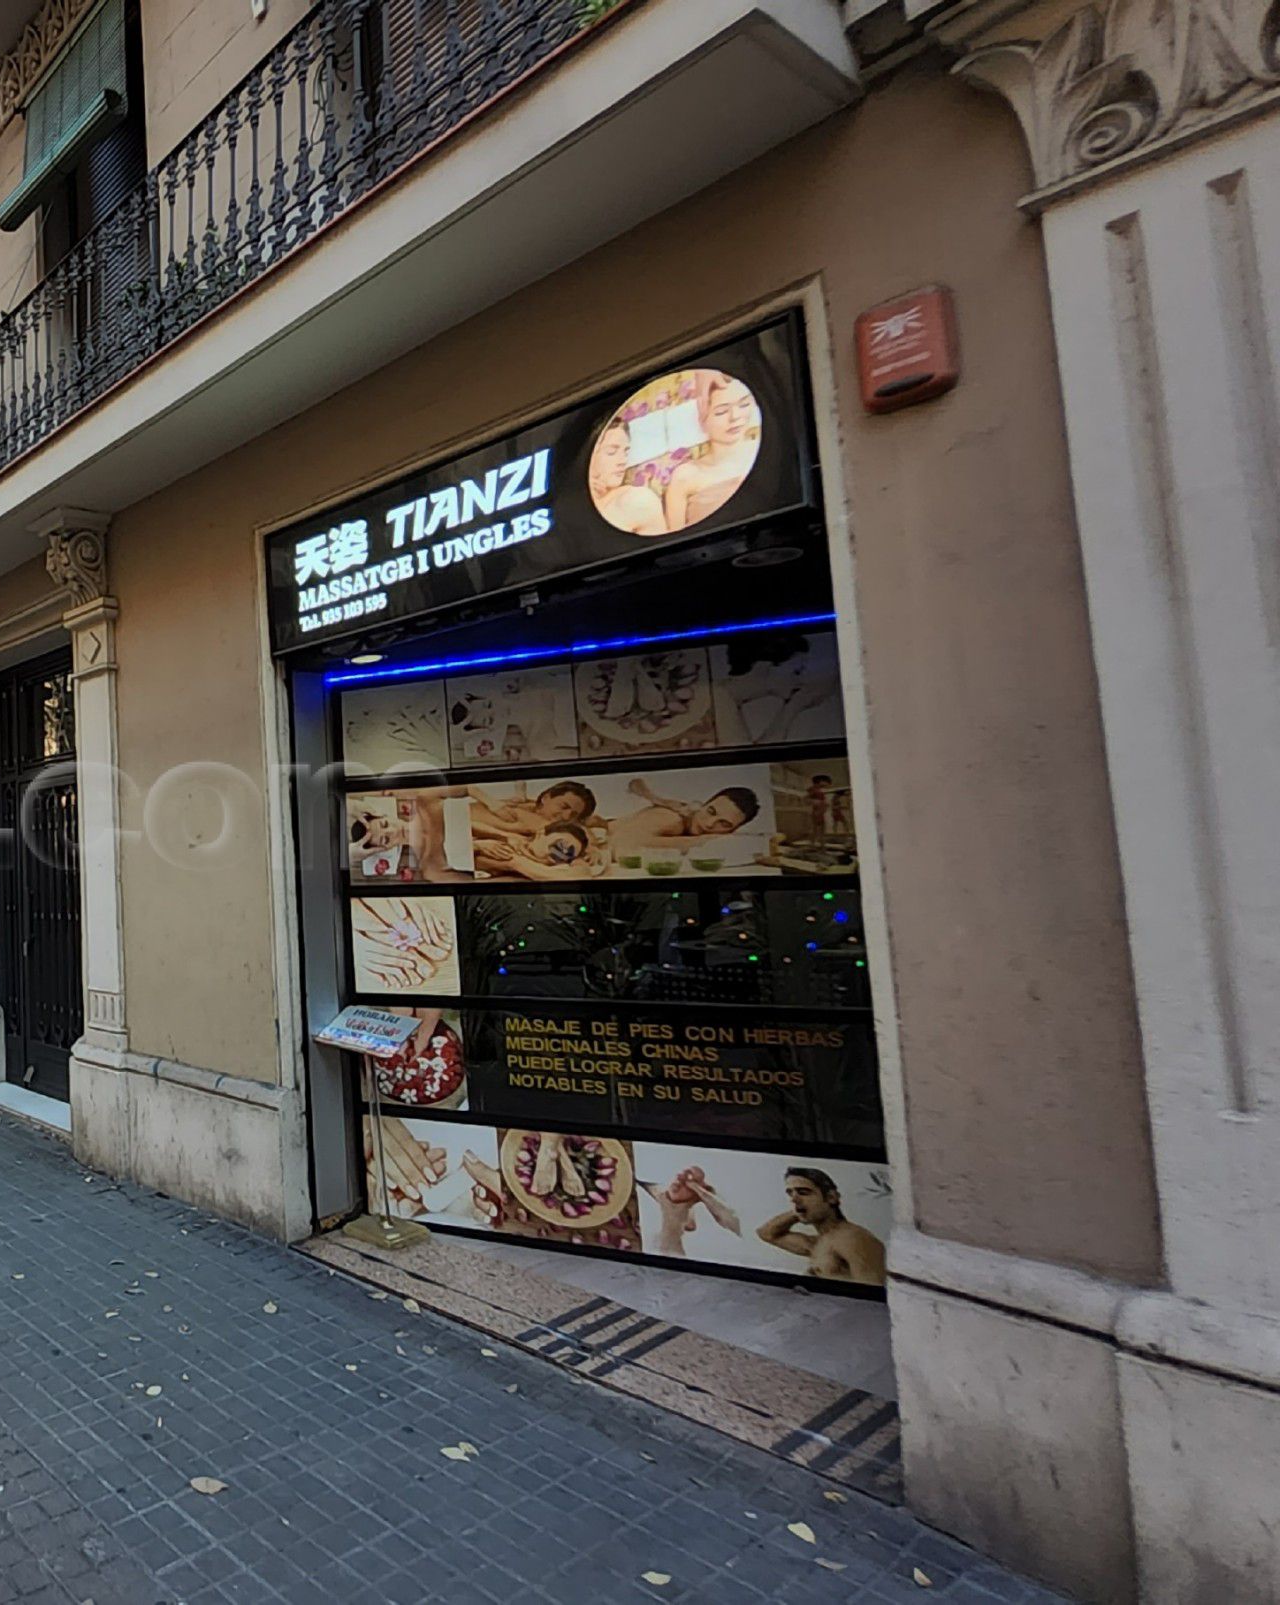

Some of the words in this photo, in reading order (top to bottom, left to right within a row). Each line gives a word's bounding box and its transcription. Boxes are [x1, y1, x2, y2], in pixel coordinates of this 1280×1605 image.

[386, 448, 551, 548] TIANZI
[294, 519, 369, 586] 天姿
[298, 553, 414, 612] MASSATGE
[418, 550, 430, 574] I
[432, 508, 552, 567] UNGLES
[505, 1017, 581, 1035] MASAJE
[591, 1021, 619, 1036] DE
[629, 1023, 673, 1039] PIES
[685, 1026, 734, 1043] CON
[744, 1028, 844, 1047] HIERBAS
[505, 1036, 631, 1057] MEDICINALES
[641, 1043, 719, 1061] CHINAS
[507, 1054, 567, 1071] PUEDE
[570, 1059, 653, 1078] LOGRAR
[663, 1064, 805, 1086] RESULTADOS
[509, 1073, 607, 1095] NOTABLES
[617, 1082, 643, 1098] EN
[653, 1085, 680, 1100] SU
[691, 1087, 763, 1106] SALUD
